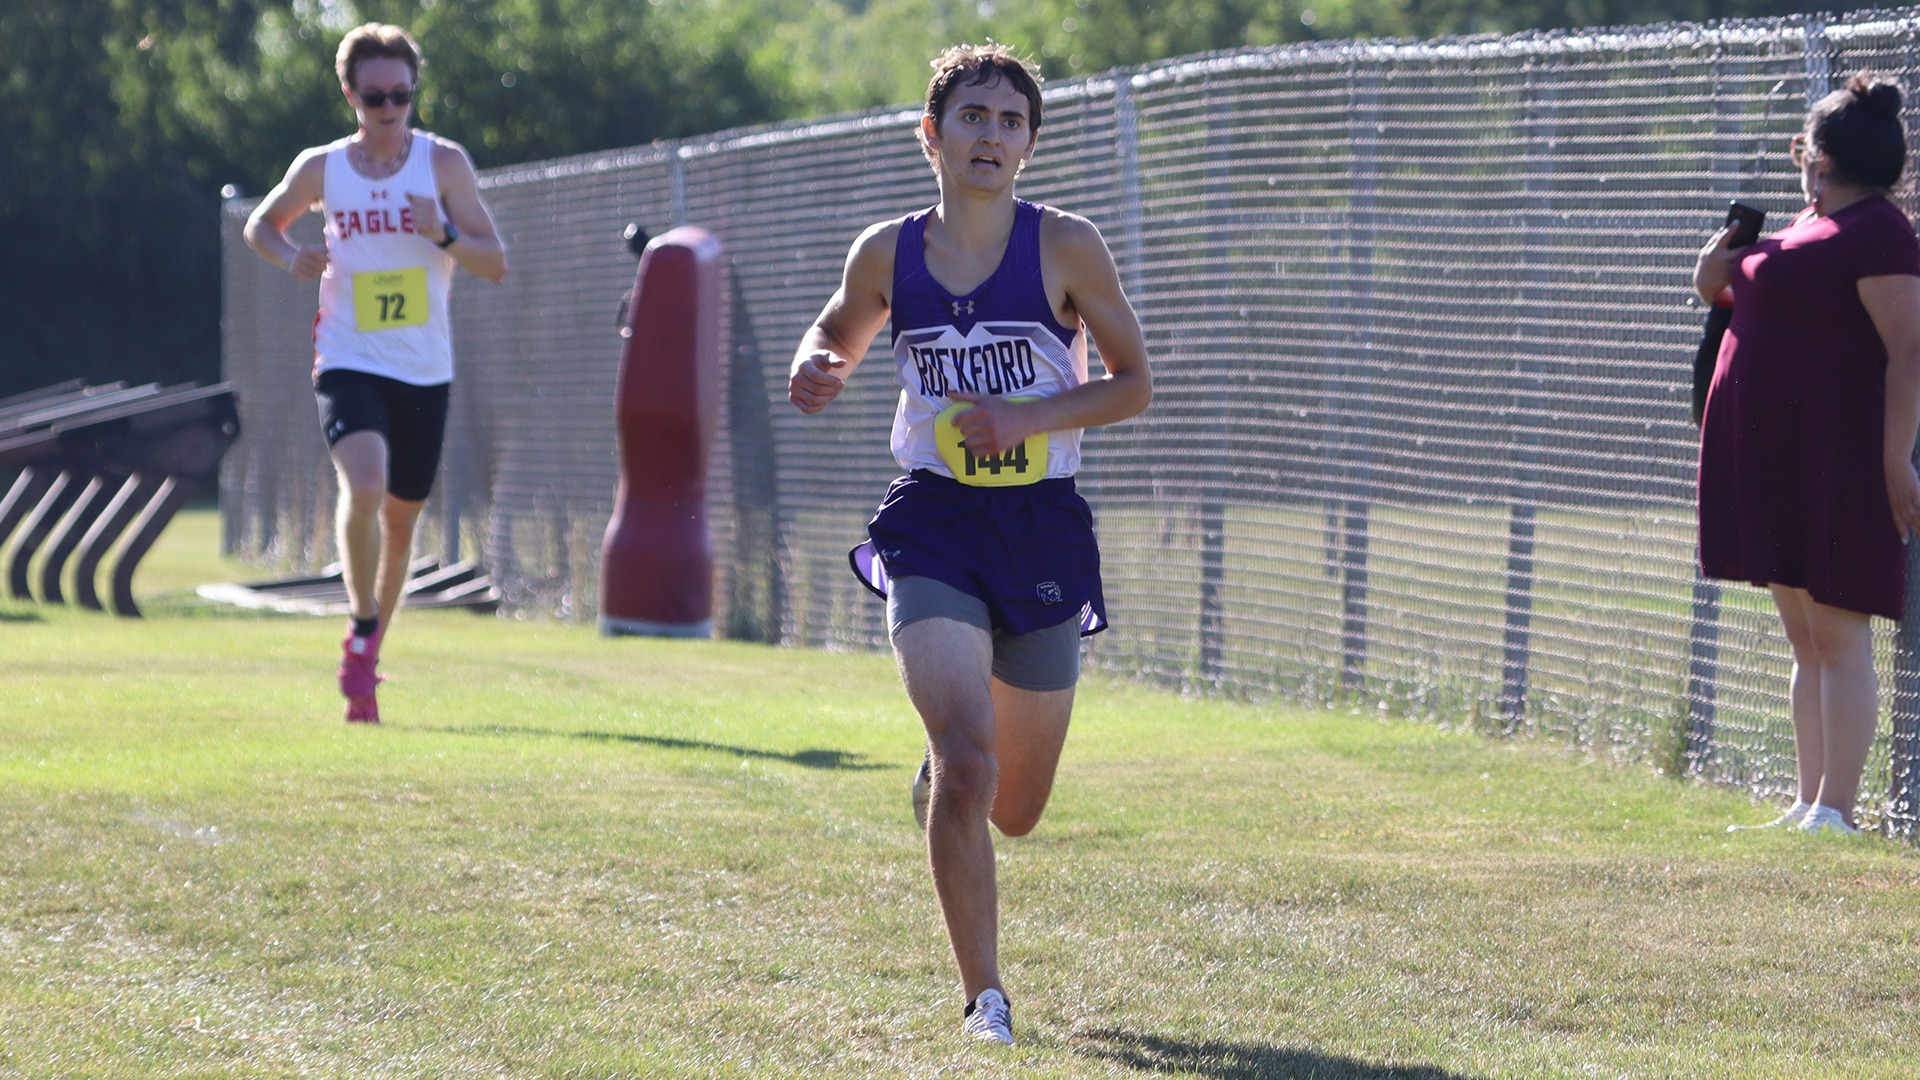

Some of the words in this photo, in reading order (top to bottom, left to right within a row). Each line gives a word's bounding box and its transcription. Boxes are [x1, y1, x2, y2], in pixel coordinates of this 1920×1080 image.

[333, 207, 421, 240] EAGLE
[375, 293, 406, 322] 72
[908, 338, 1036, 398] ROCKFORD
